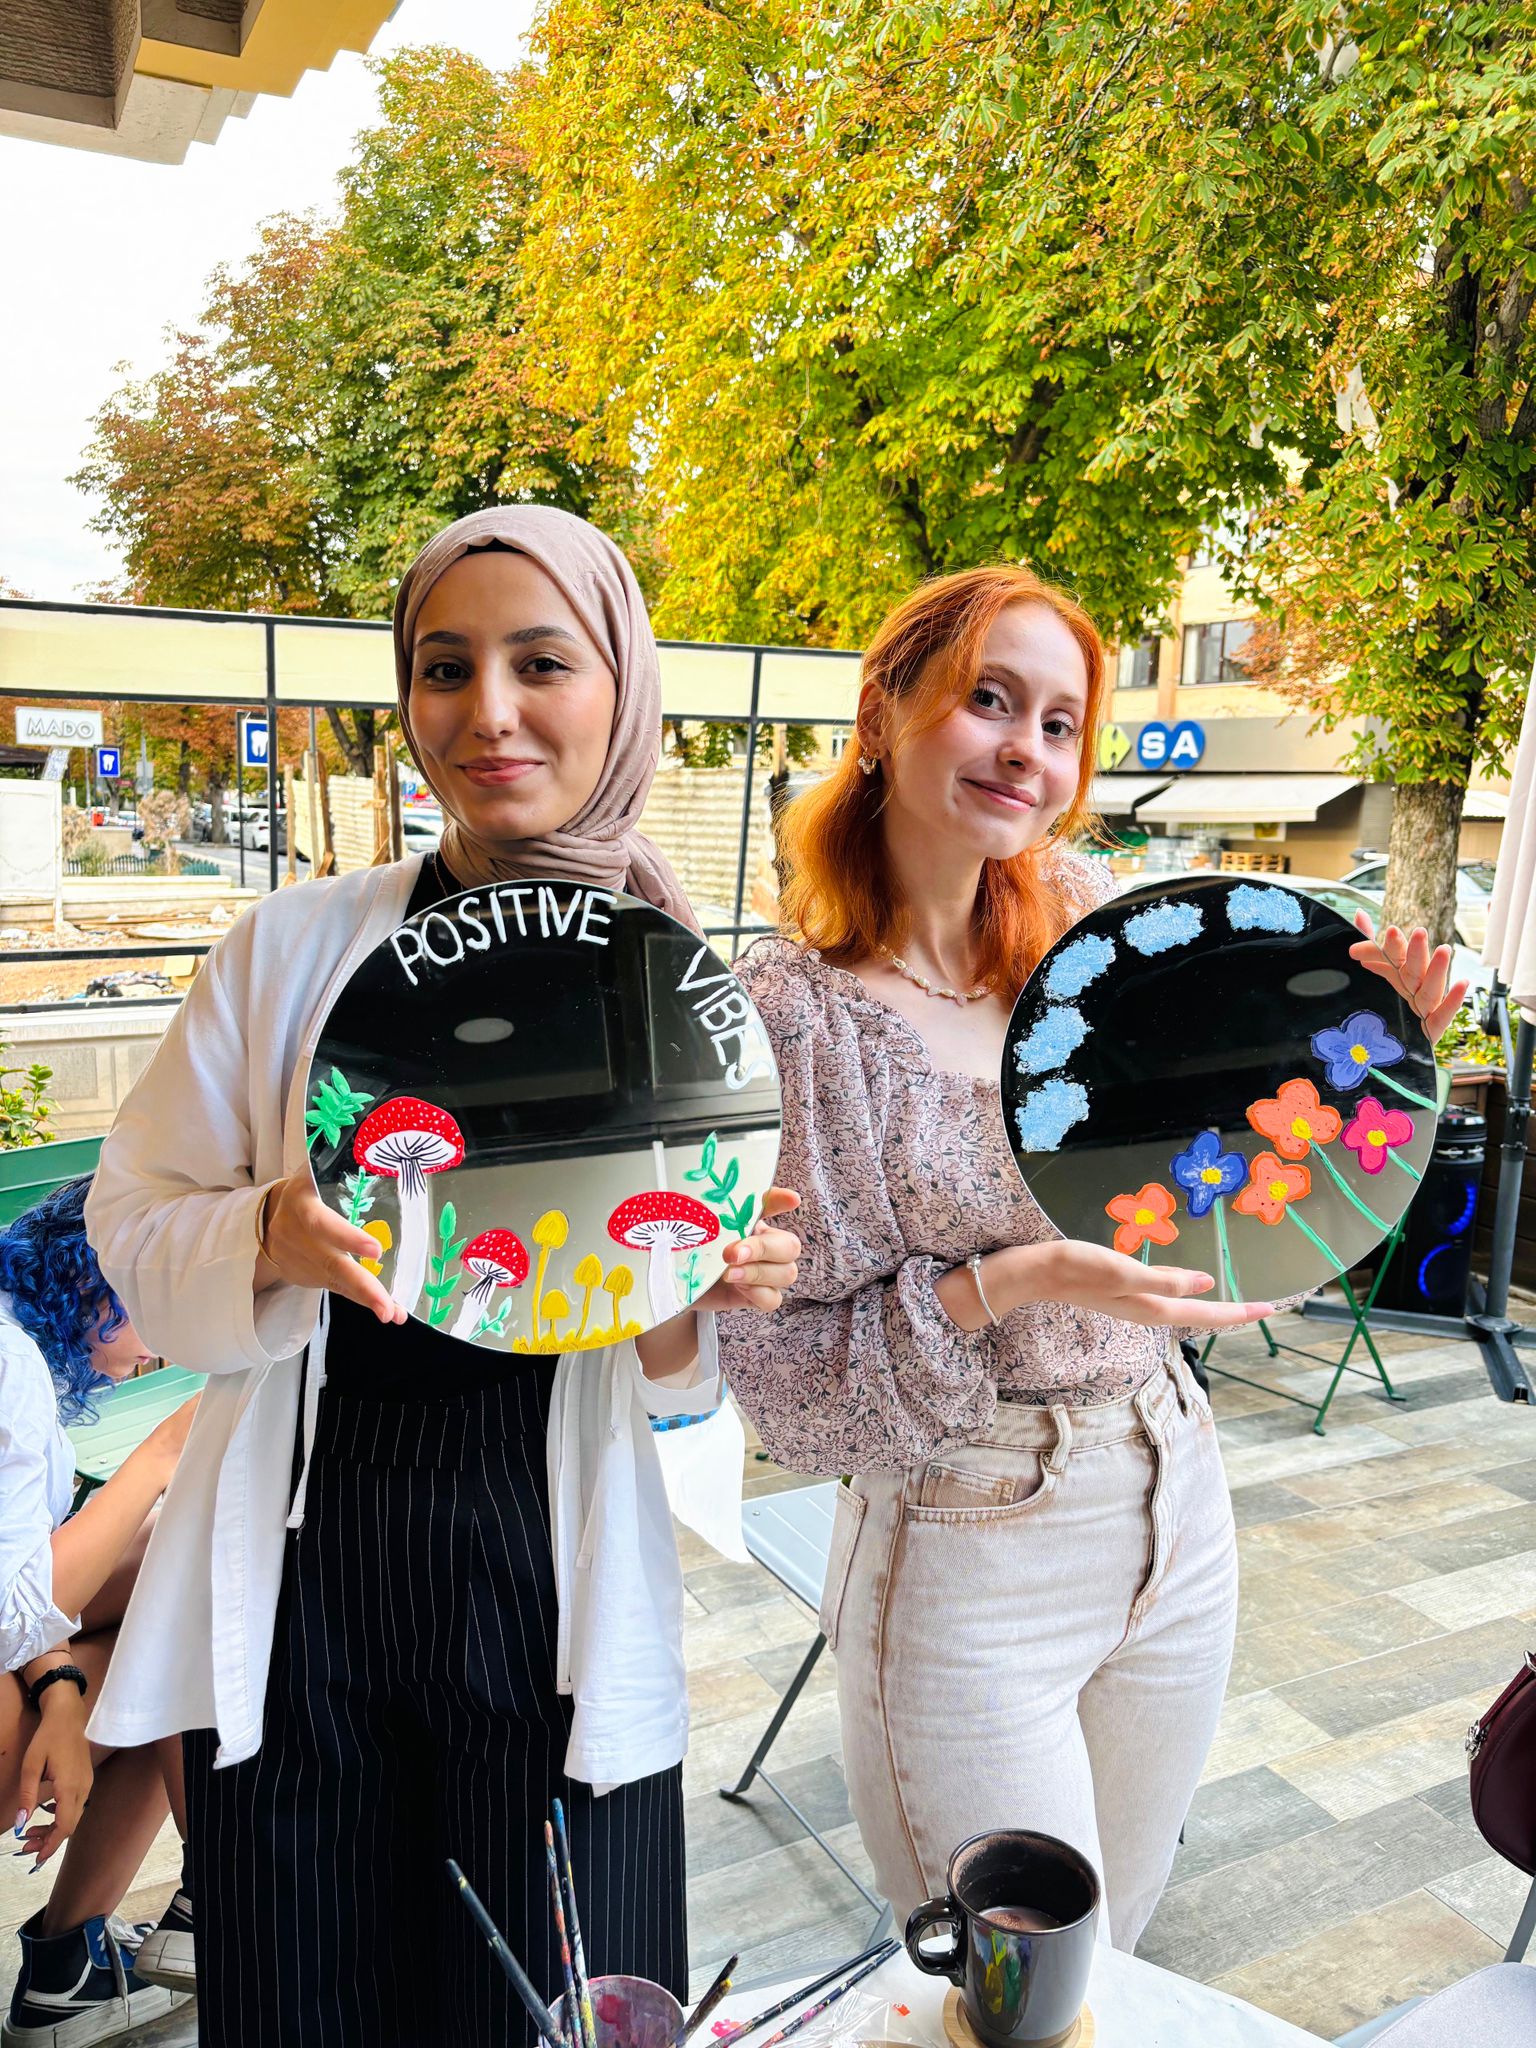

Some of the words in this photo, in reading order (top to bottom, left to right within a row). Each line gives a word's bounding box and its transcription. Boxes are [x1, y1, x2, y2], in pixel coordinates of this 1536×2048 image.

[27, 717, 95, 739] MADO
[1141, 730, 1199, 759] SA
[390, 886, 618, 986] POSITIVE
